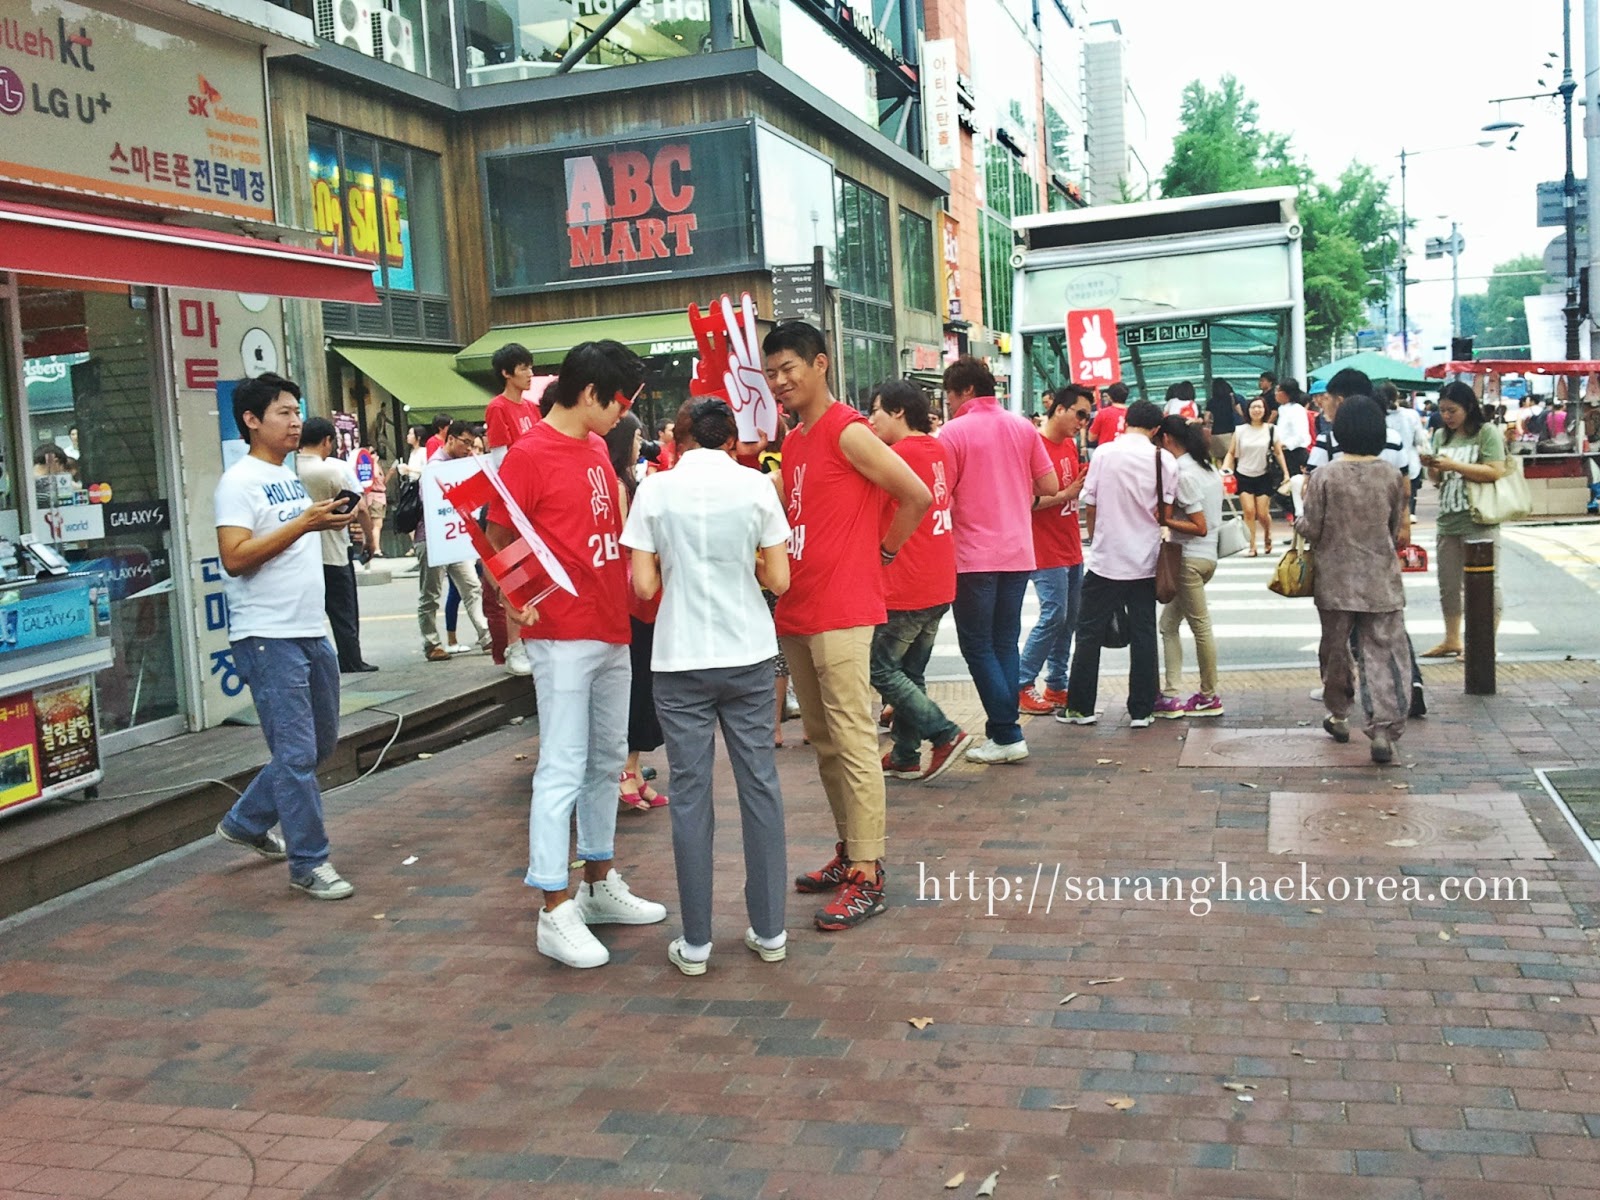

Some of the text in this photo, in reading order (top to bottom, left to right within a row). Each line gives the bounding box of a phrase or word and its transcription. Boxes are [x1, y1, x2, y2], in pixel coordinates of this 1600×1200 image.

[0, 16, 95, 72] lleh kt
[31, 82, 112, 124] LG U+
[187, 94, 209, 118] SK
[109, 141, 191, 189] 스마트폰
[193, 157, 265, 203] 전문매장
[563, 143, 696, 224] ABC
[566, 213, 698, 269] MART
[262, 479, 306, 506] HOLLIS
[109, 509, 152, 527] GALAXY
